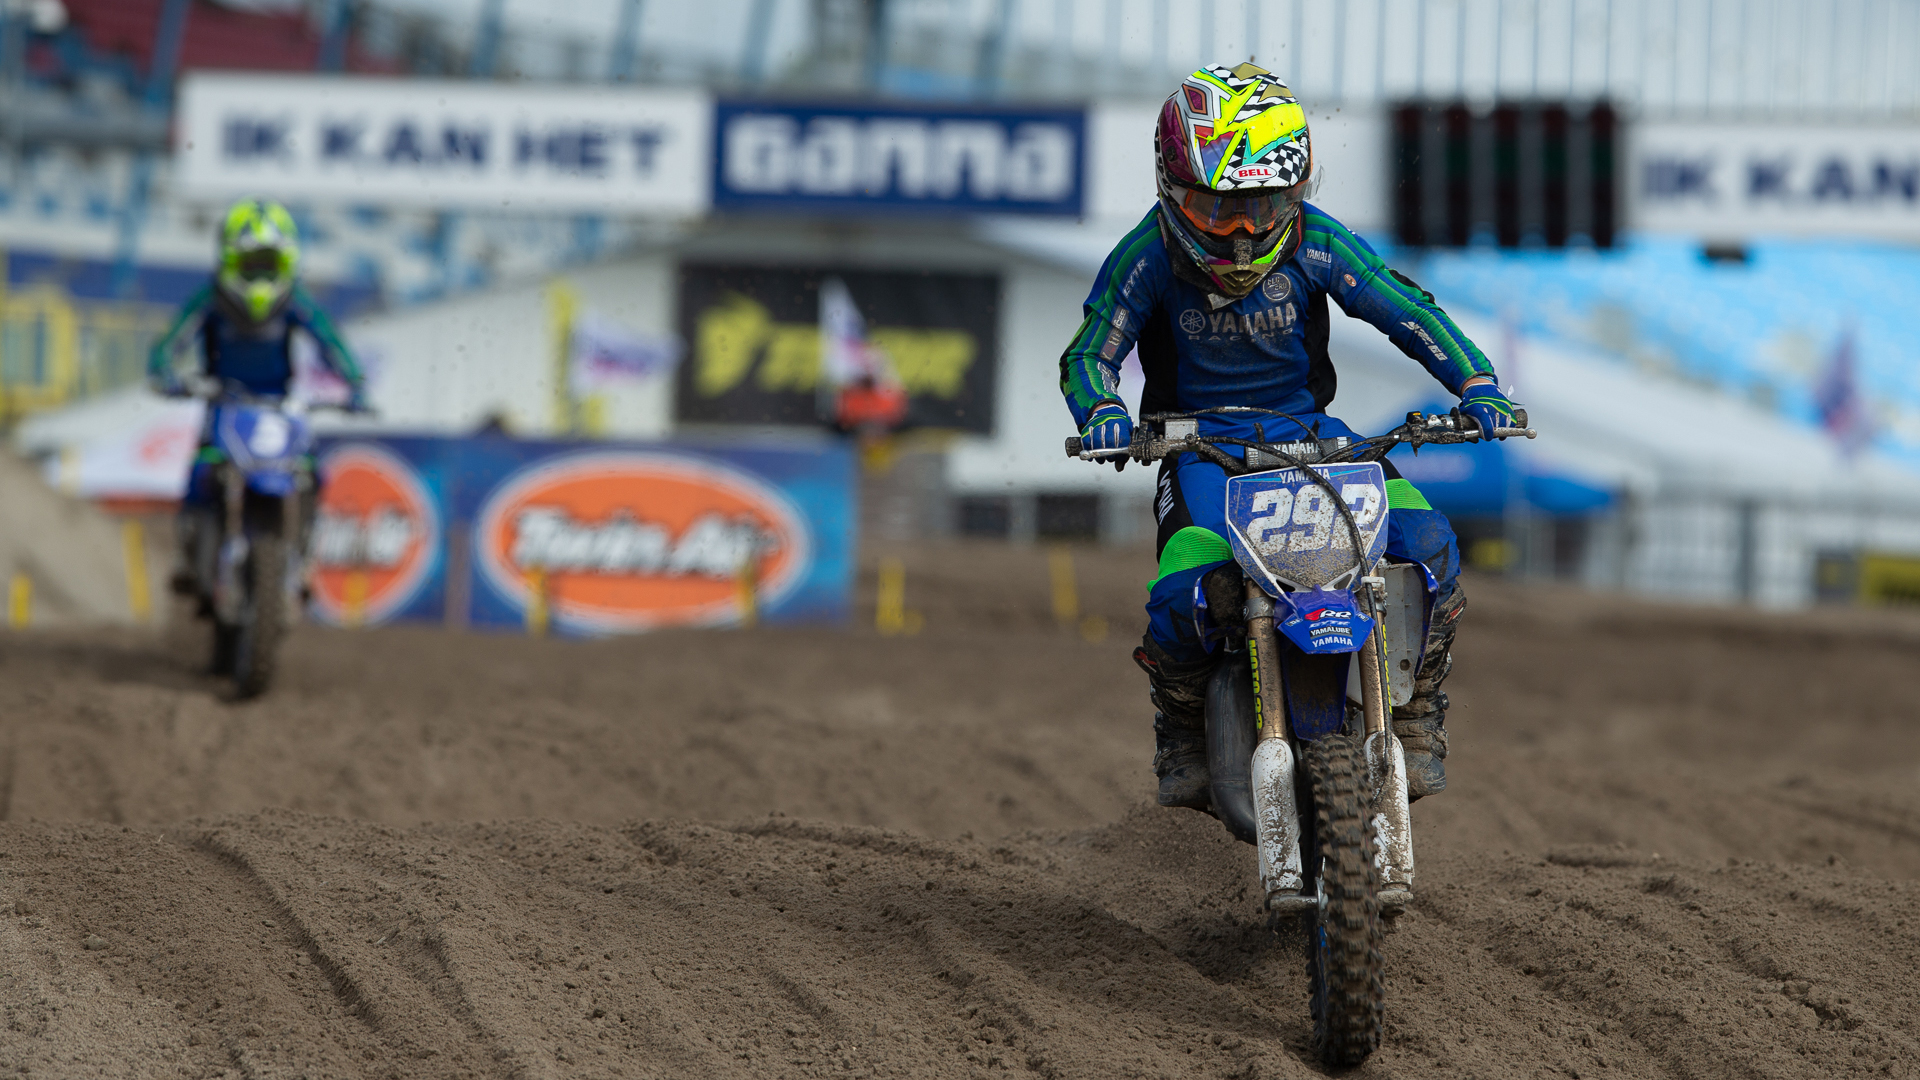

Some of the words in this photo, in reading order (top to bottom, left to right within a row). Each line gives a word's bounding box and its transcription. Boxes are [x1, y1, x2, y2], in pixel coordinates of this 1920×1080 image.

[319, 114, 490, 168] KAN
[513, 121, 670, 178] HET
[1238, 168, 1272, 178] BELL
[1208, 302, 1297, 335] YAMAHA
[1246, 483, 1382, 556] 292
[1310, 626, 1351, 636] YAMALUBE
[1312, 636, 1354, 648] YAMAHA
